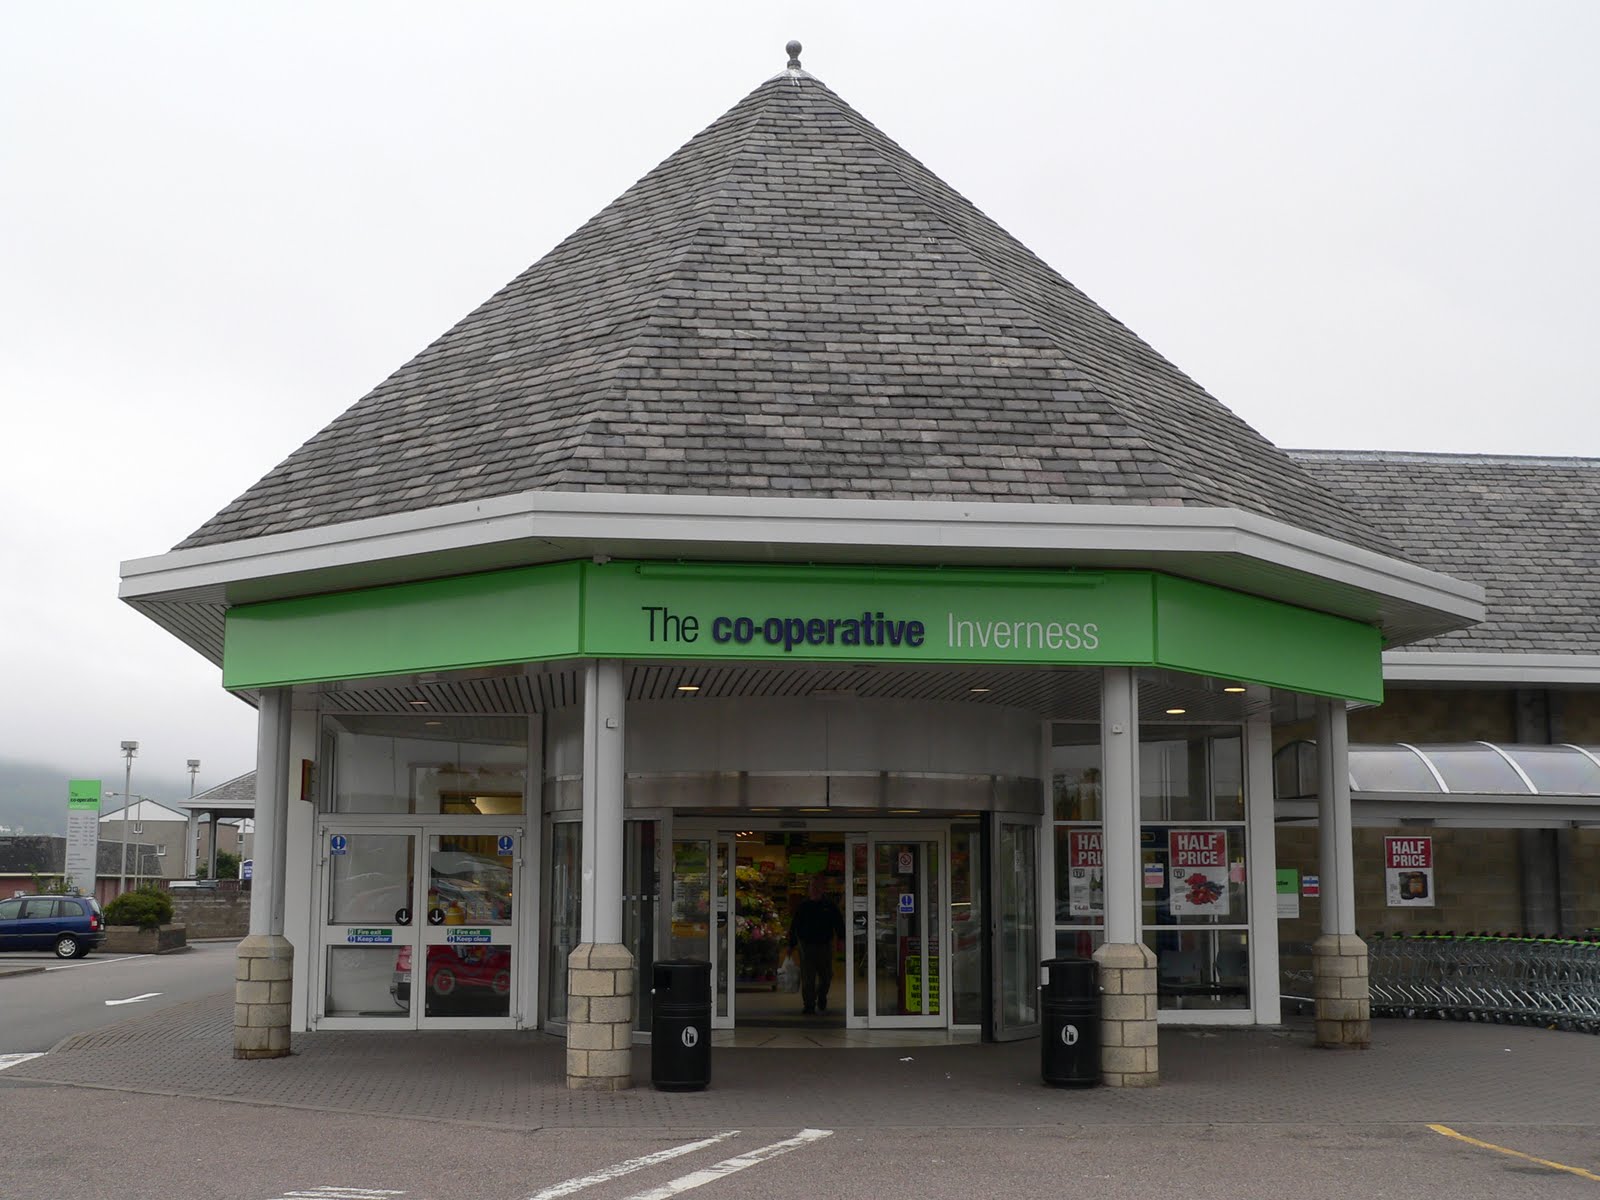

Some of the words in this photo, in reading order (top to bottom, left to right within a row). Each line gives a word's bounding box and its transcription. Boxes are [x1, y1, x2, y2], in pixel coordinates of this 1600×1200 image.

[641, 606, 699, 644] The
[712, 611, 925, 653] co-operative
[947, 612, 1099, 650] Inverness
[1077, 834, 1103, 849] HA
[1177, 835, 1217, 850] HALF
[1392, 841, 1425, 854] HALF
[1078, 851, 1103, 865] PRI
[1178, 851, 1218, 865] PRICE
[1392, 855, 1426, 866] PRICE
